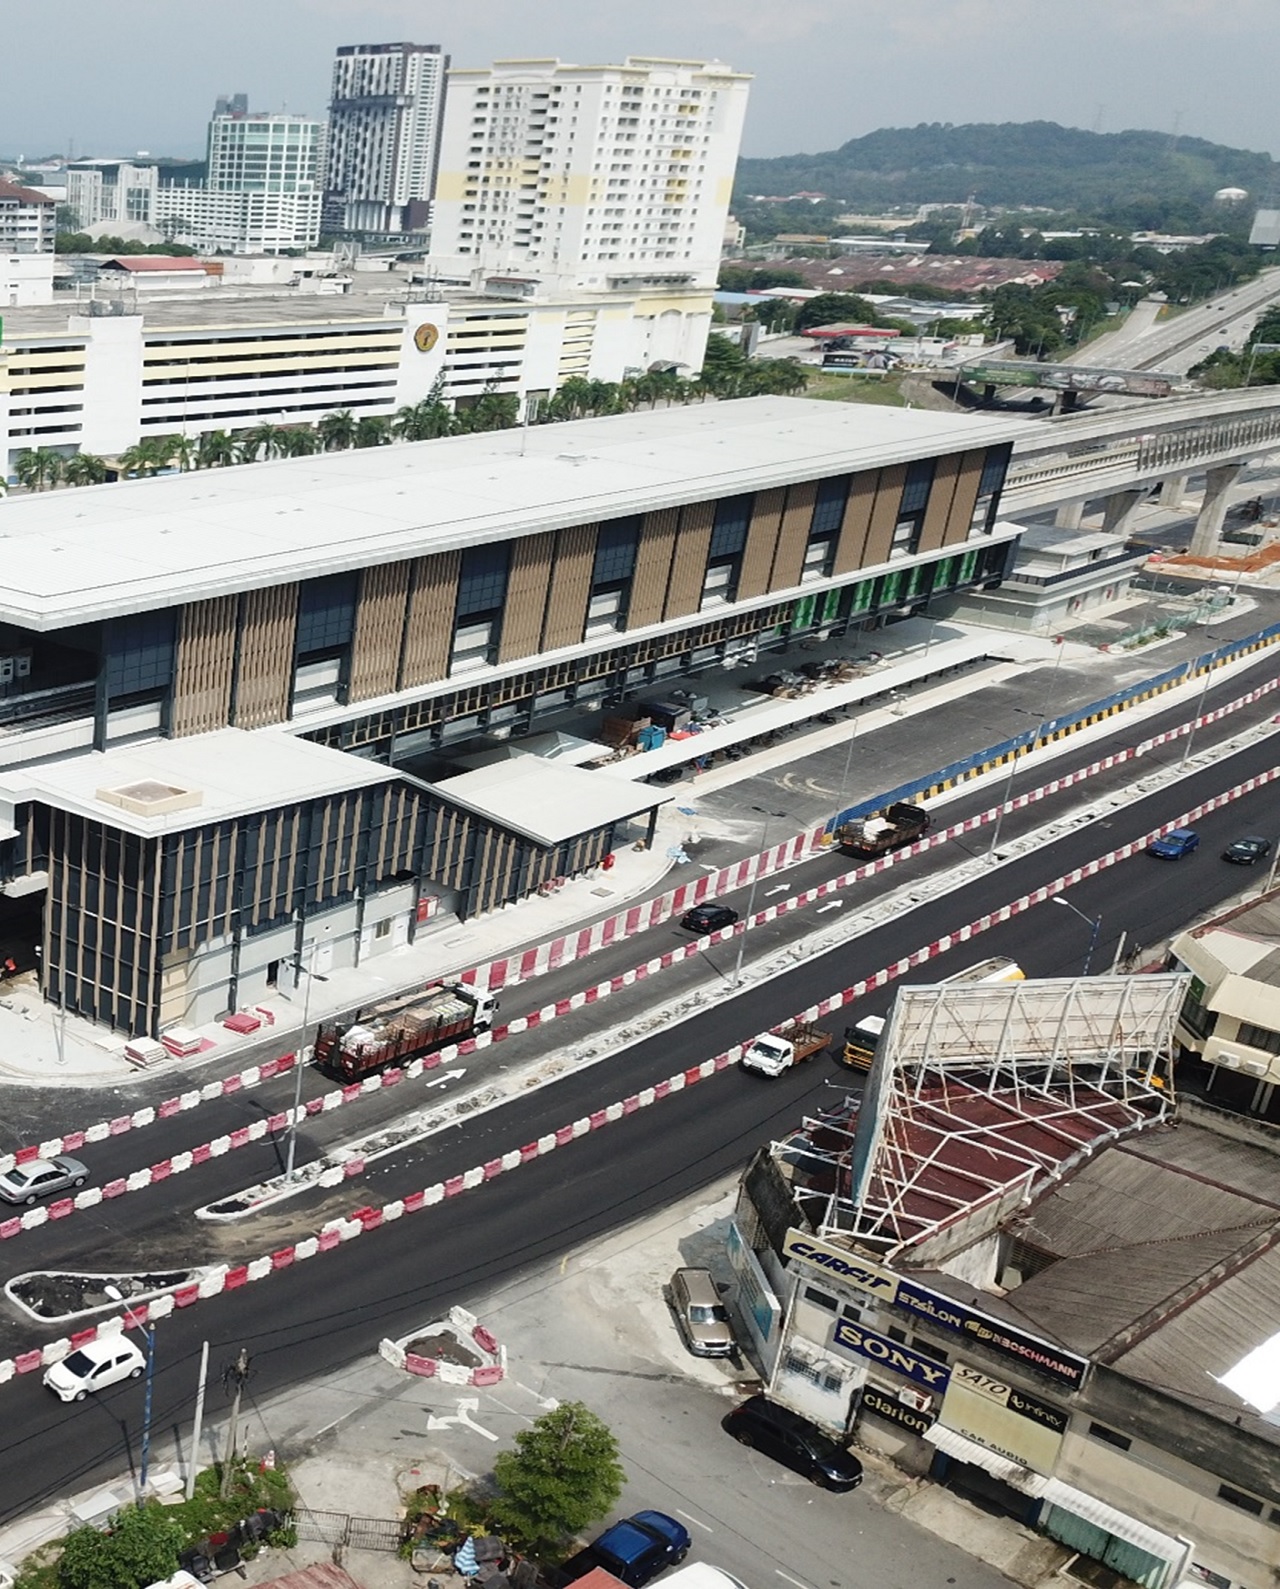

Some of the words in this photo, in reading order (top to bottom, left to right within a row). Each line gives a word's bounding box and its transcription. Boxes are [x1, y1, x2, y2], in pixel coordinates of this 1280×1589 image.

[839, 1325, 946, 1384] SONY
[957, 1368, 1008, 1394] SATO
[960, 1428, 985, 1444] CAR
[990, 1443, 1028, 1466] AUDIO
